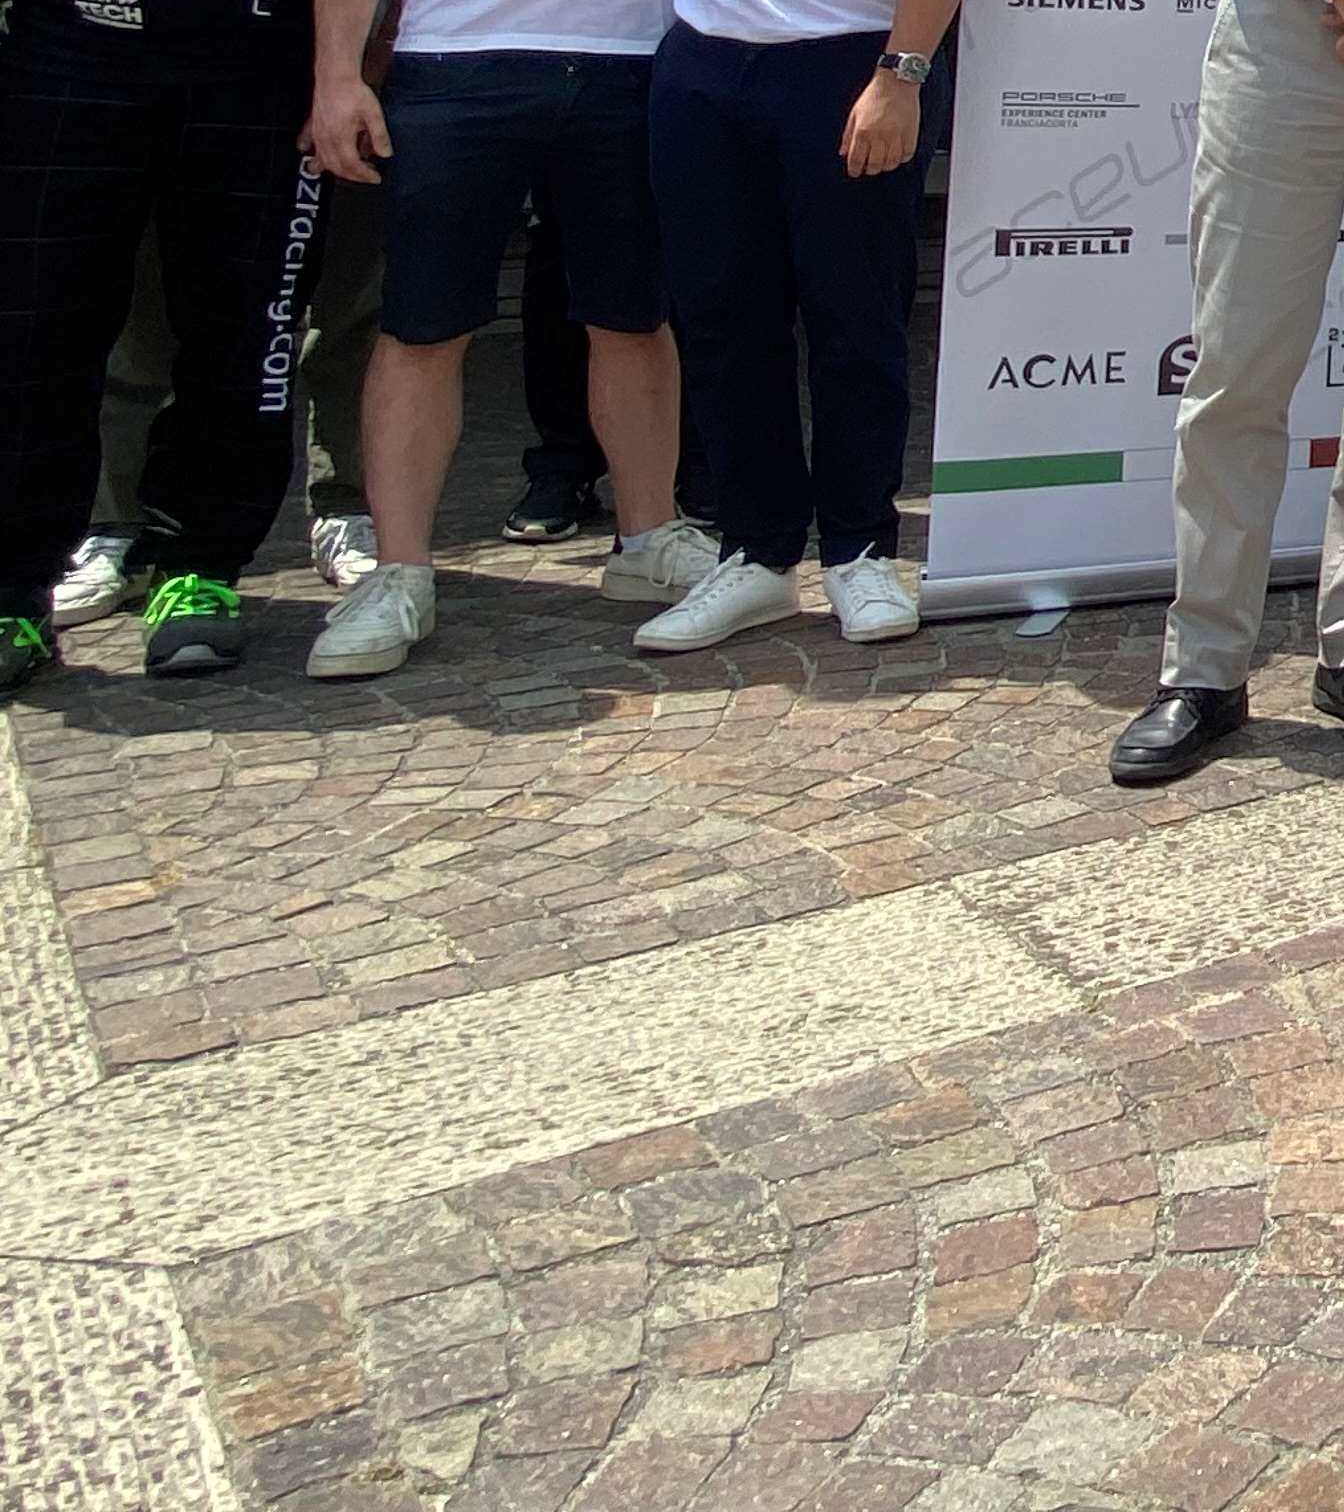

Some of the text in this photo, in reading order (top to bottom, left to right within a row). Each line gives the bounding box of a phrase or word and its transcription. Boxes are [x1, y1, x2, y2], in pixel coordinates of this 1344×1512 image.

[1002, 90, 1127, 103] PORSCHE
[1001, 108, 1107, 119] EXPERIENCE CENTER
[995, 227, 1134, 257] PIRELLI
[987, 350, 1127, 390] ACME
